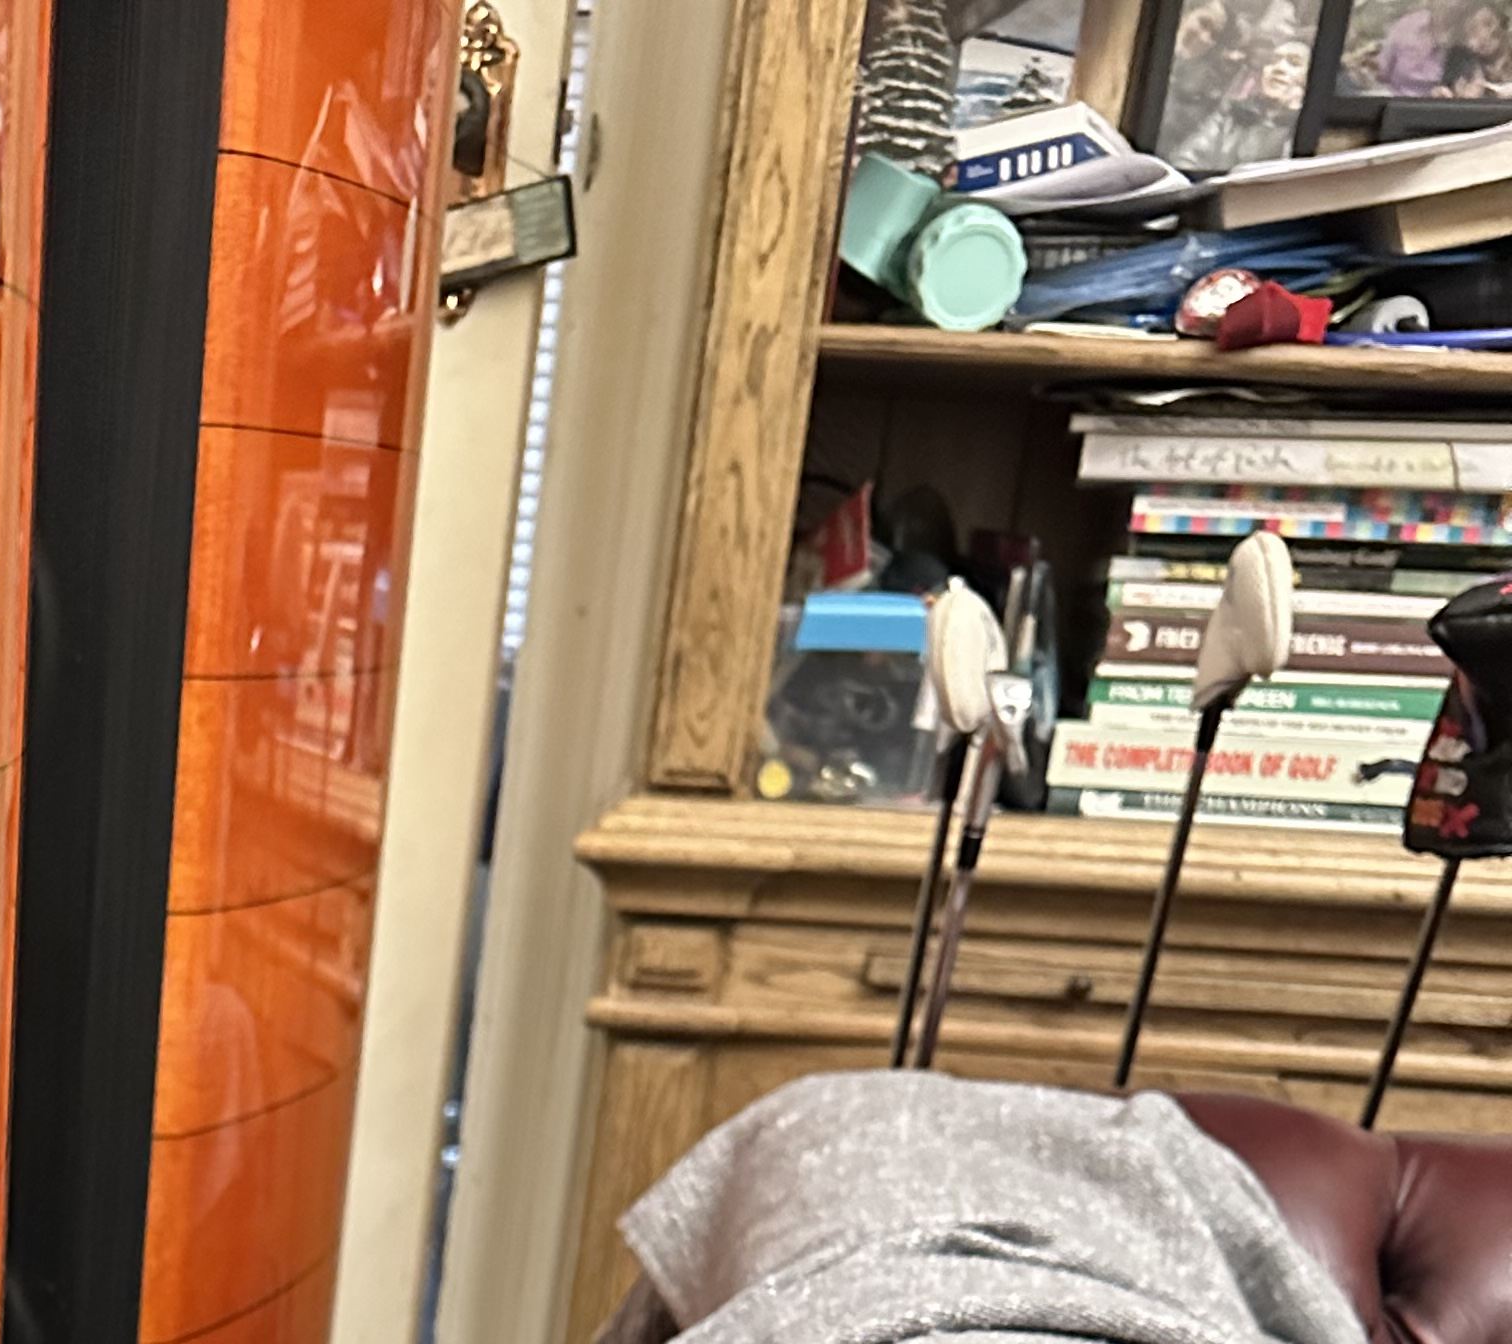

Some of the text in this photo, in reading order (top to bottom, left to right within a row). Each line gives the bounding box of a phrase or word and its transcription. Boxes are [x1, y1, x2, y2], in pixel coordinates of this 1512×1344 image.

[1065, 741, 1099, 770] THE
[1258, 751, 1286, 779] OF
[1288, 752, 1337, 782] GOLF
